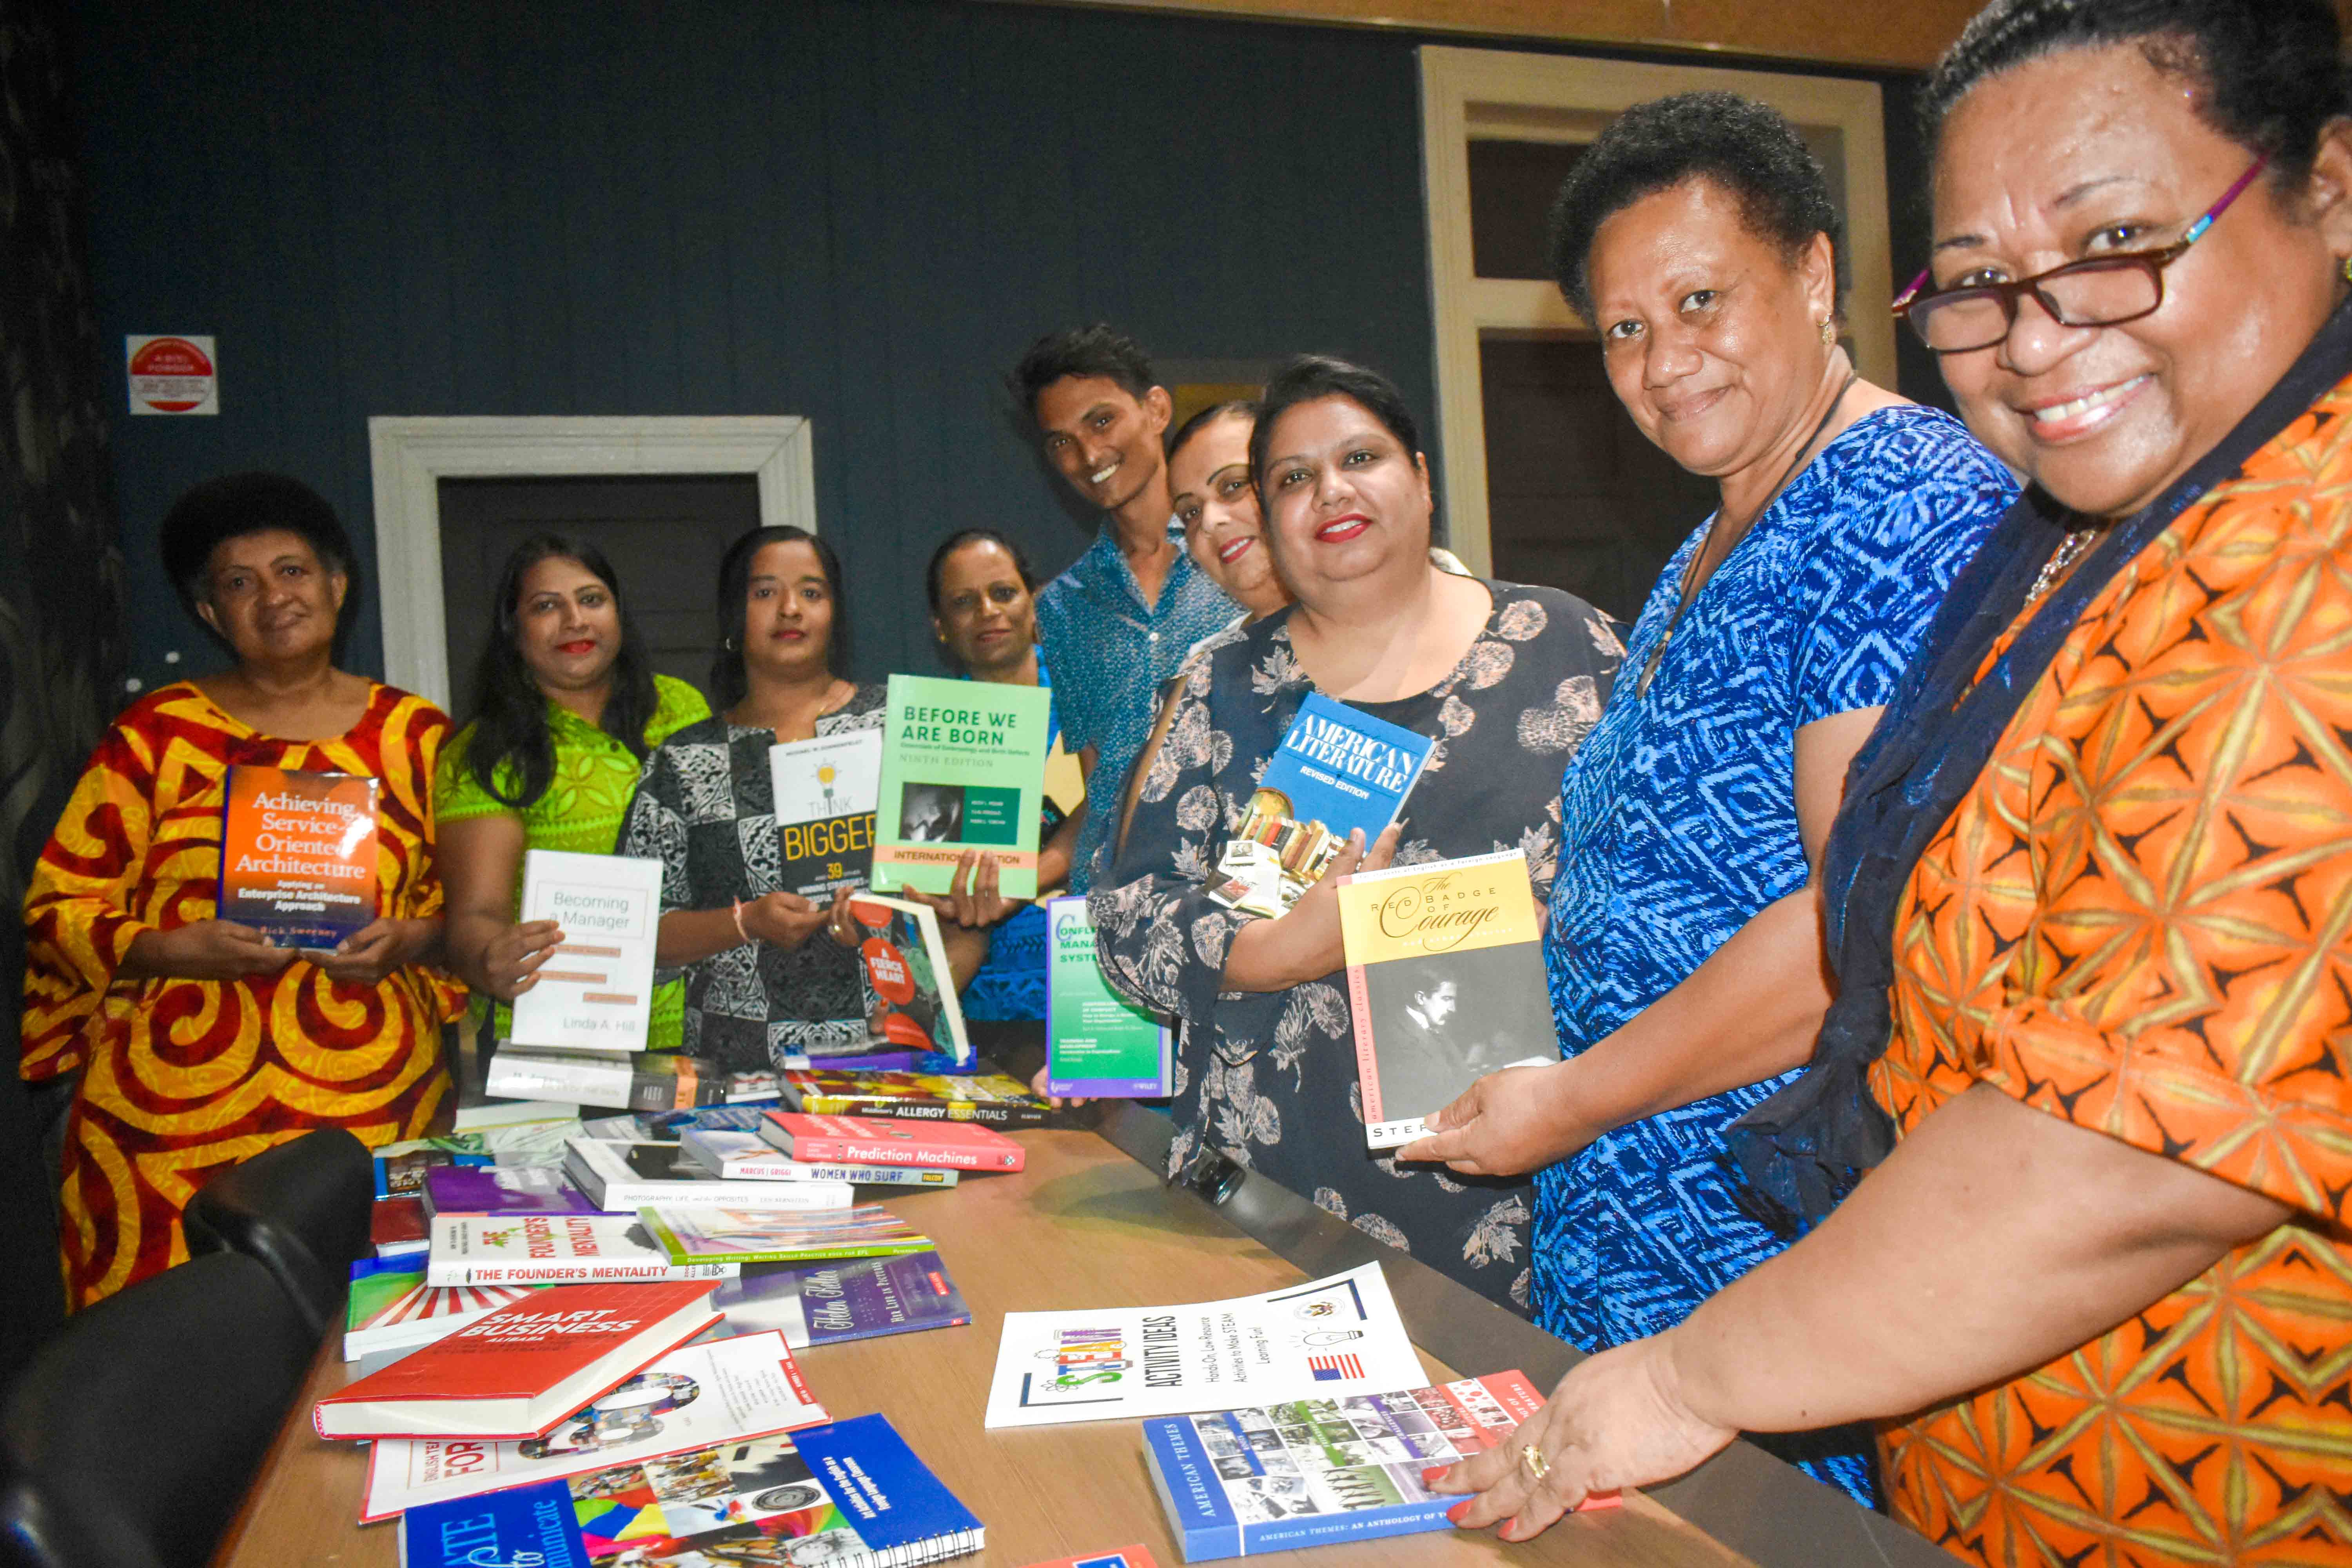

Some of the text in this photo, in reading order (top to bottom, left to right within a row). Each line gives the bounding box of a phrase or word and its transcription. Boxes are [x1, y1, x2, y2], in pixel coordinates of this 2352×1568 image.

[904, 706, 1017, 728] BEFORE WE
[902, 726, 1004, 745] ARE BORN
[1295, 715, 1420, 775] AMERICAN
[900, 754, 993, 768] NINTH EDITION
[1286, 730, 1408, 793] LITERATURE
[1299, 766, 1370, 800] REVISED EDITION
[252, 792, 354, 821] Achieving
[808, 796, 853, 818] THINK
[261, 813, 346, 835] Service-
[234, 853, 366, 879] Architecture
[894, 850, 976, 863] INTERNATIO
[828, 863, 843, 880] 39
[1423, 871, 1462, 893] The
[238, 888, 361, 904] Enterprise Architecture
[277, 880, 312, 891] Applying
[274, 900, 325, 912] Approach
[554, 891, 629, 913] Becoming
[1370, 887, 1496, 912] RED BADGE
[1428, 903, 1450, 913] OF
[563, 911, 631, 929] Manager
[1379, 886, 1499, 951] Courage
[1060, 941, 1095, 949] MANA
[563, 1017, 596, 1030] Linda
[615, 1020, 635, 1032] Hill
[896, 1106, 946, 1118] ALLERGY
[947, 1110, 1008, 1121] ESSENTIALS
[1373, 1124, 1426, 1137] STEP
[848, 1146, 977, 1165] Prediction Machines
[740, 1167, 765, 1175] MARCUS
[811, 1169, 846, 1180] WOMEN
[849, 1170, 871, 1180] WHO
[875, 1172, 903, 1181] SURF
[483, 1231, 508, 1246] THE
[523, 1218, 558, 1259] FOUNDER'S
[565, 1217, 602, 1258] MENTALITY
[475, 1267, 668, 1280] THE FOUNDER'S MENTALITY
[805, 1270, 854, 1330] Helen Keller
[487, 1309, 617, 1326] SMART
[1220, 1312, 1237, 1333] STEAM
[459, 1320, 640, 1338] BUSINESS
[1142, 1316, 1183, 1388] ACTIVITY IDEAS
[1224, 1334, 1239, 1349] Make
[1255, 1339, 1270, 1365] Learning
[1055, 1327, 1123, 1387] STEAM
[1232, 1356, 1248, 1383] Activities
[444, 1442, 485, 1479] FOR
[1163, 1423, 1216, 1517] AMERICAN THEMES
[1259, 1529, 1306, 1542] AMERICAN
[1309, 1524, 1349, 1536] THEMES:
[1367, 1514, 1421, 1528] ANTHOLOGY
[1423, 1512, 1435, 1520] OF
